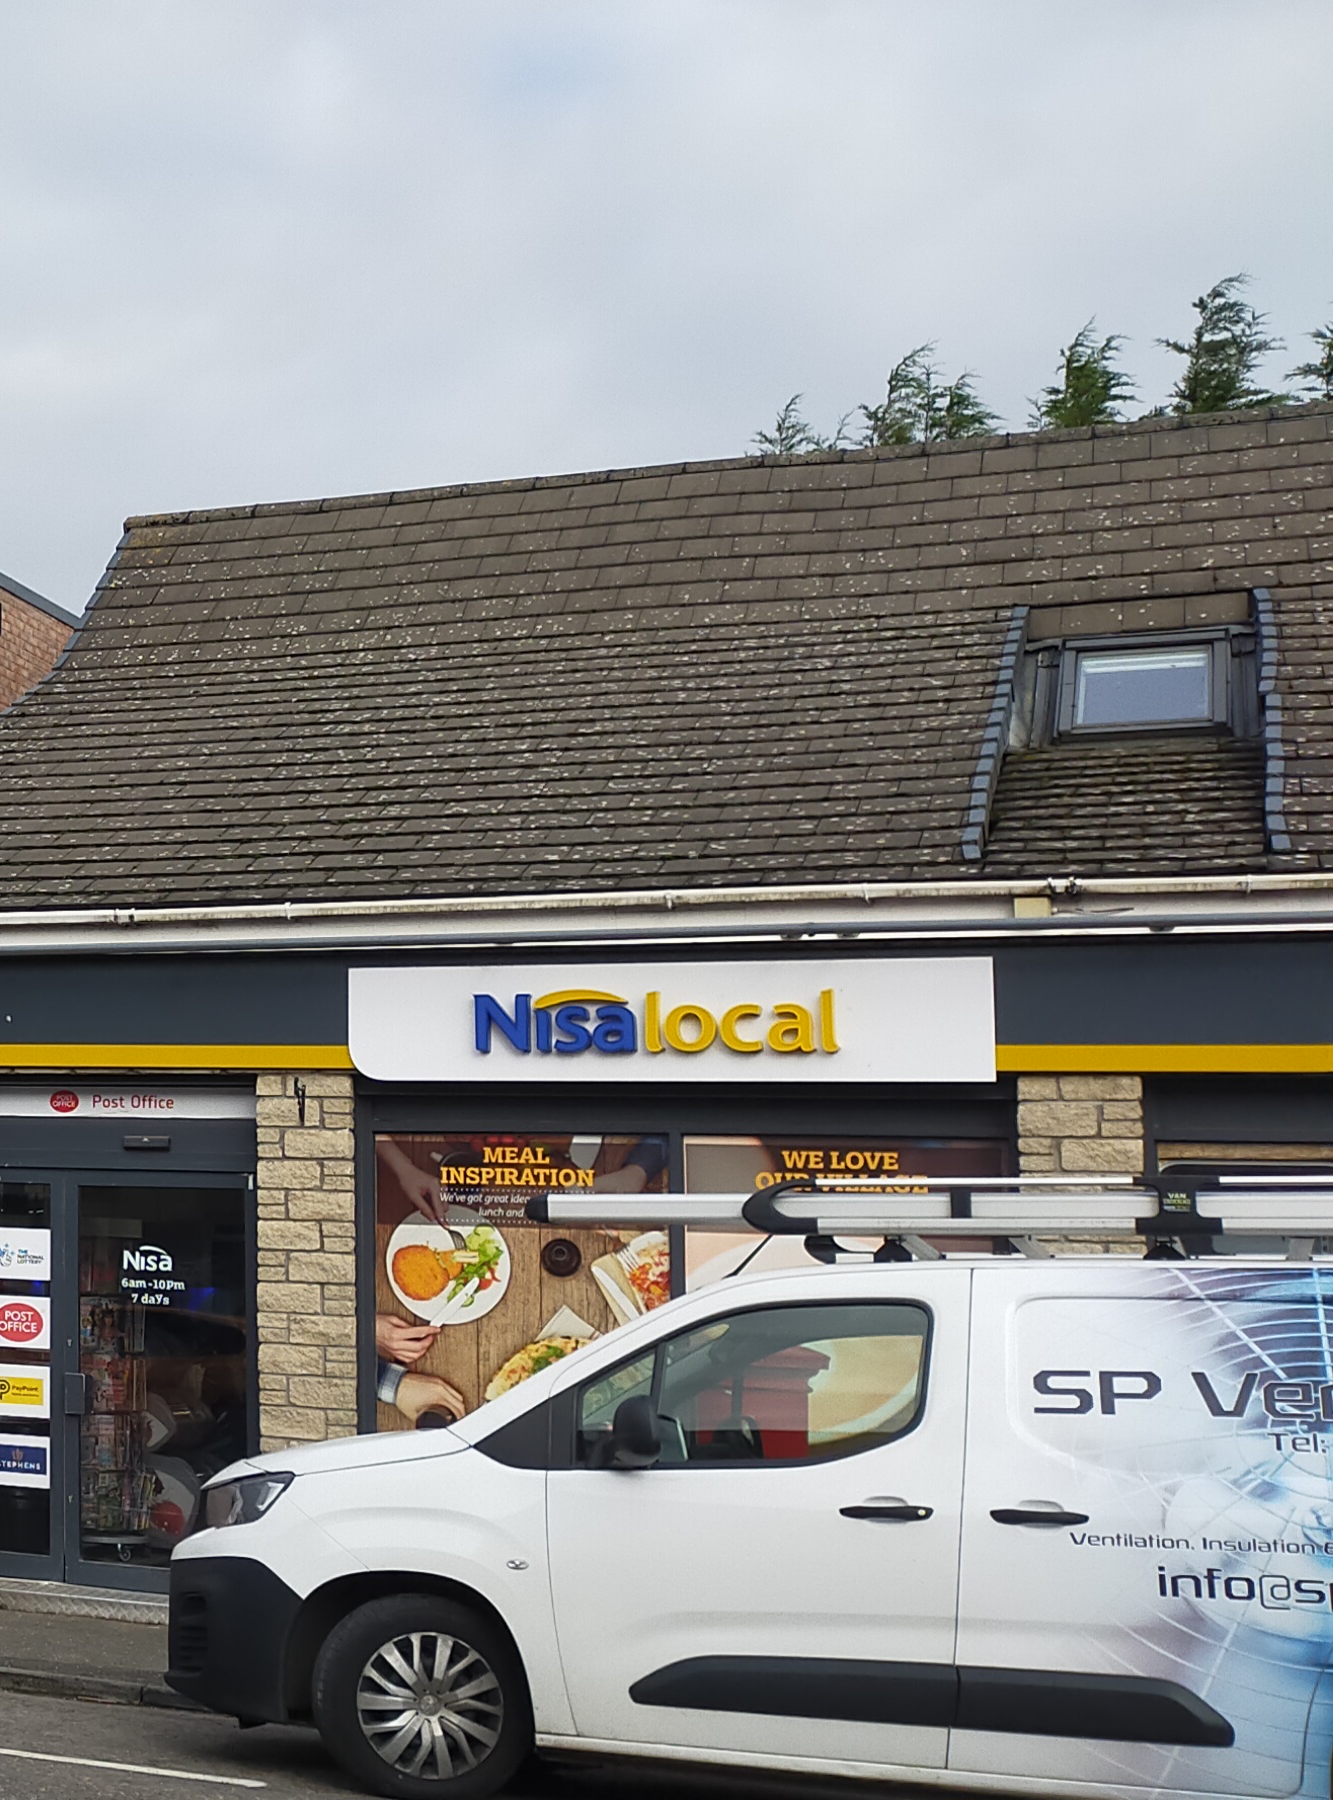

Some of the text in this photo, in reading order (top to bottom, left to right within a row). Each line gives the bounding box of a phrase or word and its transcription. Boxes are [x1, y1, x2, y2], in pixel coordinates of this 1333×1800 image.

[52, 1100, 76, 1108] OFFICE
[55, 1093, 74, 1101] POST
[92, 1094, 175, 1110] Post Office
[482, 1146, 550, 1165] MEAL
[781, 1150, 900, 1171] WE LOVE
[439, 1166, 596, 1188] INSPIRATION
[439, 1192, 466, 1203] We've
[467, 1192, 484, 1206] got
[484, 1193, 509, 1206] great
[478, 1207, 525, 1219] lunch and
[122, 1245, 173, 1272] Nisa
[130, 1292, 139, 1304] 7
[4, 1309, 35, 1322] POST
[11, 1384, 39, 1392] PayPoint
[1032, 1369, 1333, 1422] SP Ve
[1266, 1432, 1327, 1454] Tel:
[1201, 1536, 1316, 1555] Insulation
[1157, 1565, 1333, 1611] info@s
